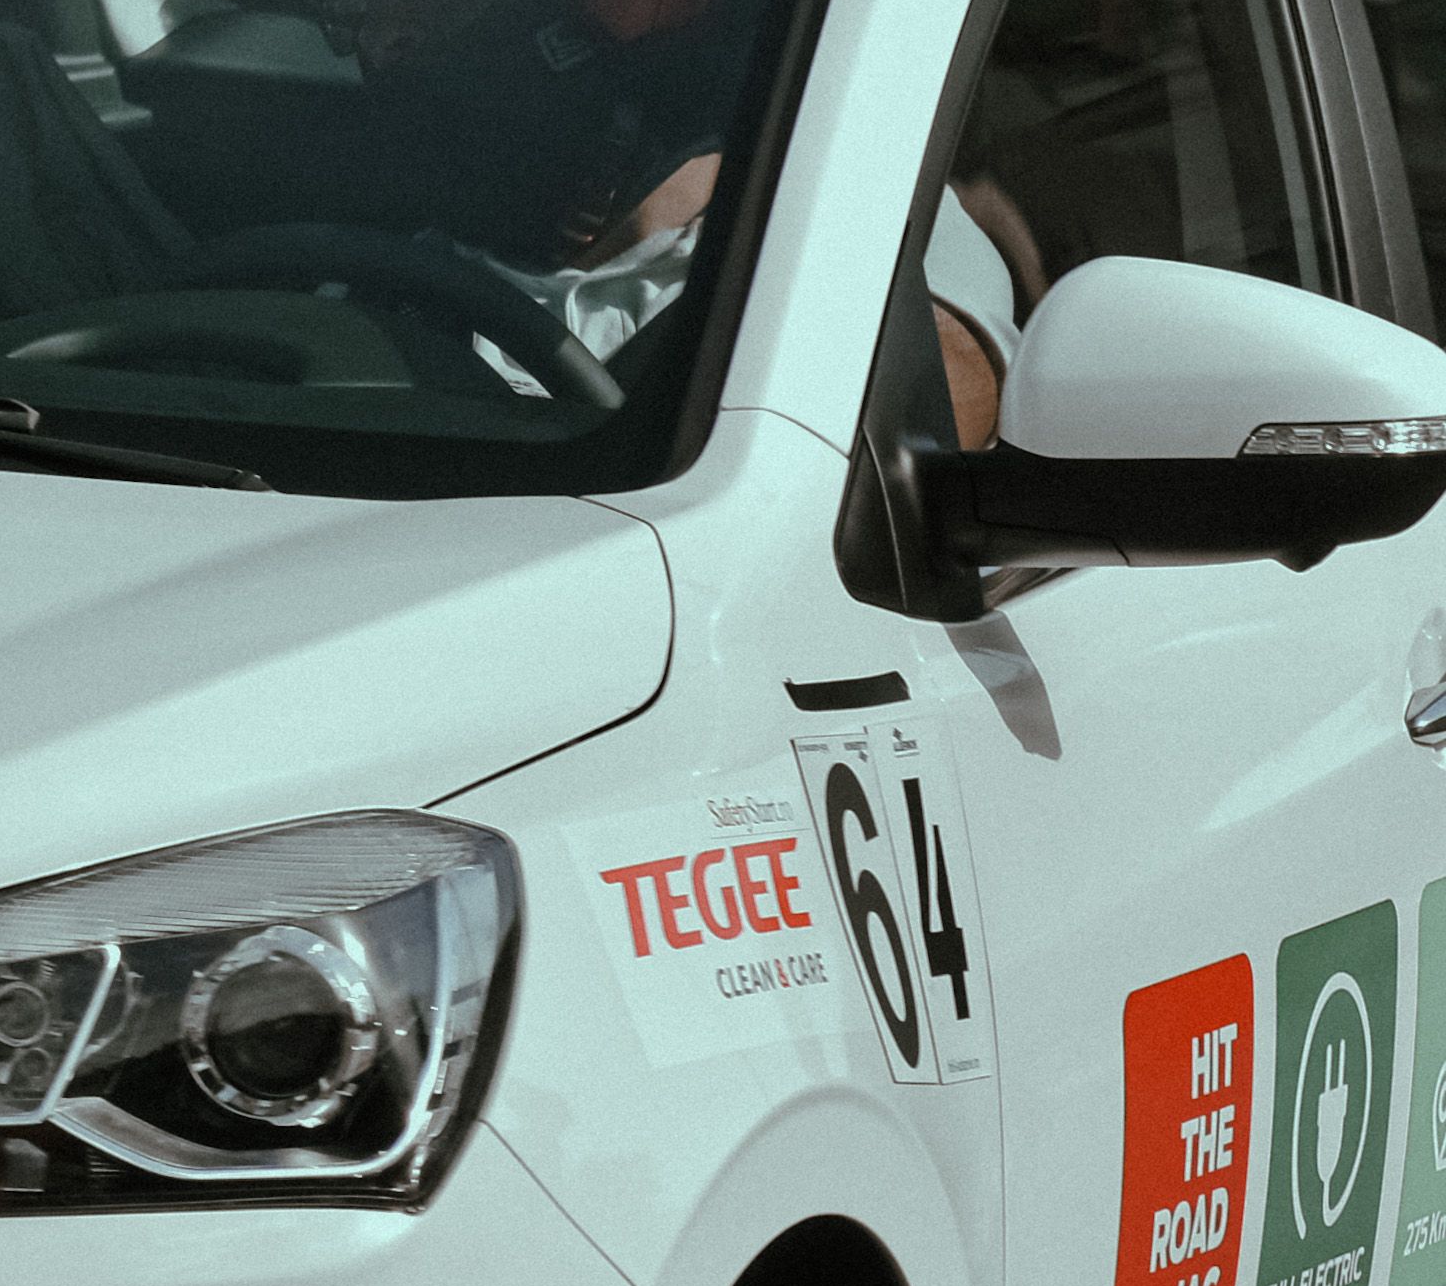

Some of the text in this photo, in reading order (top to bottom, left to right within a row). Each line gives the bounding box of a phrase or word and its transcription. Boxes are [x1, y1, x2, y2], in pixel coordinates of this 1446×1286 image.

[599, 837, 813, 958] TEGEE
[826, 762, 970, 1069] 64
[1190, 1022, 1239, 1100] HIT
[1180, 1103, 1236, 1183] THE
[1149, 1186, 1229, 1274] ROAD
[1403, 1214, 1430, 1257] 275
